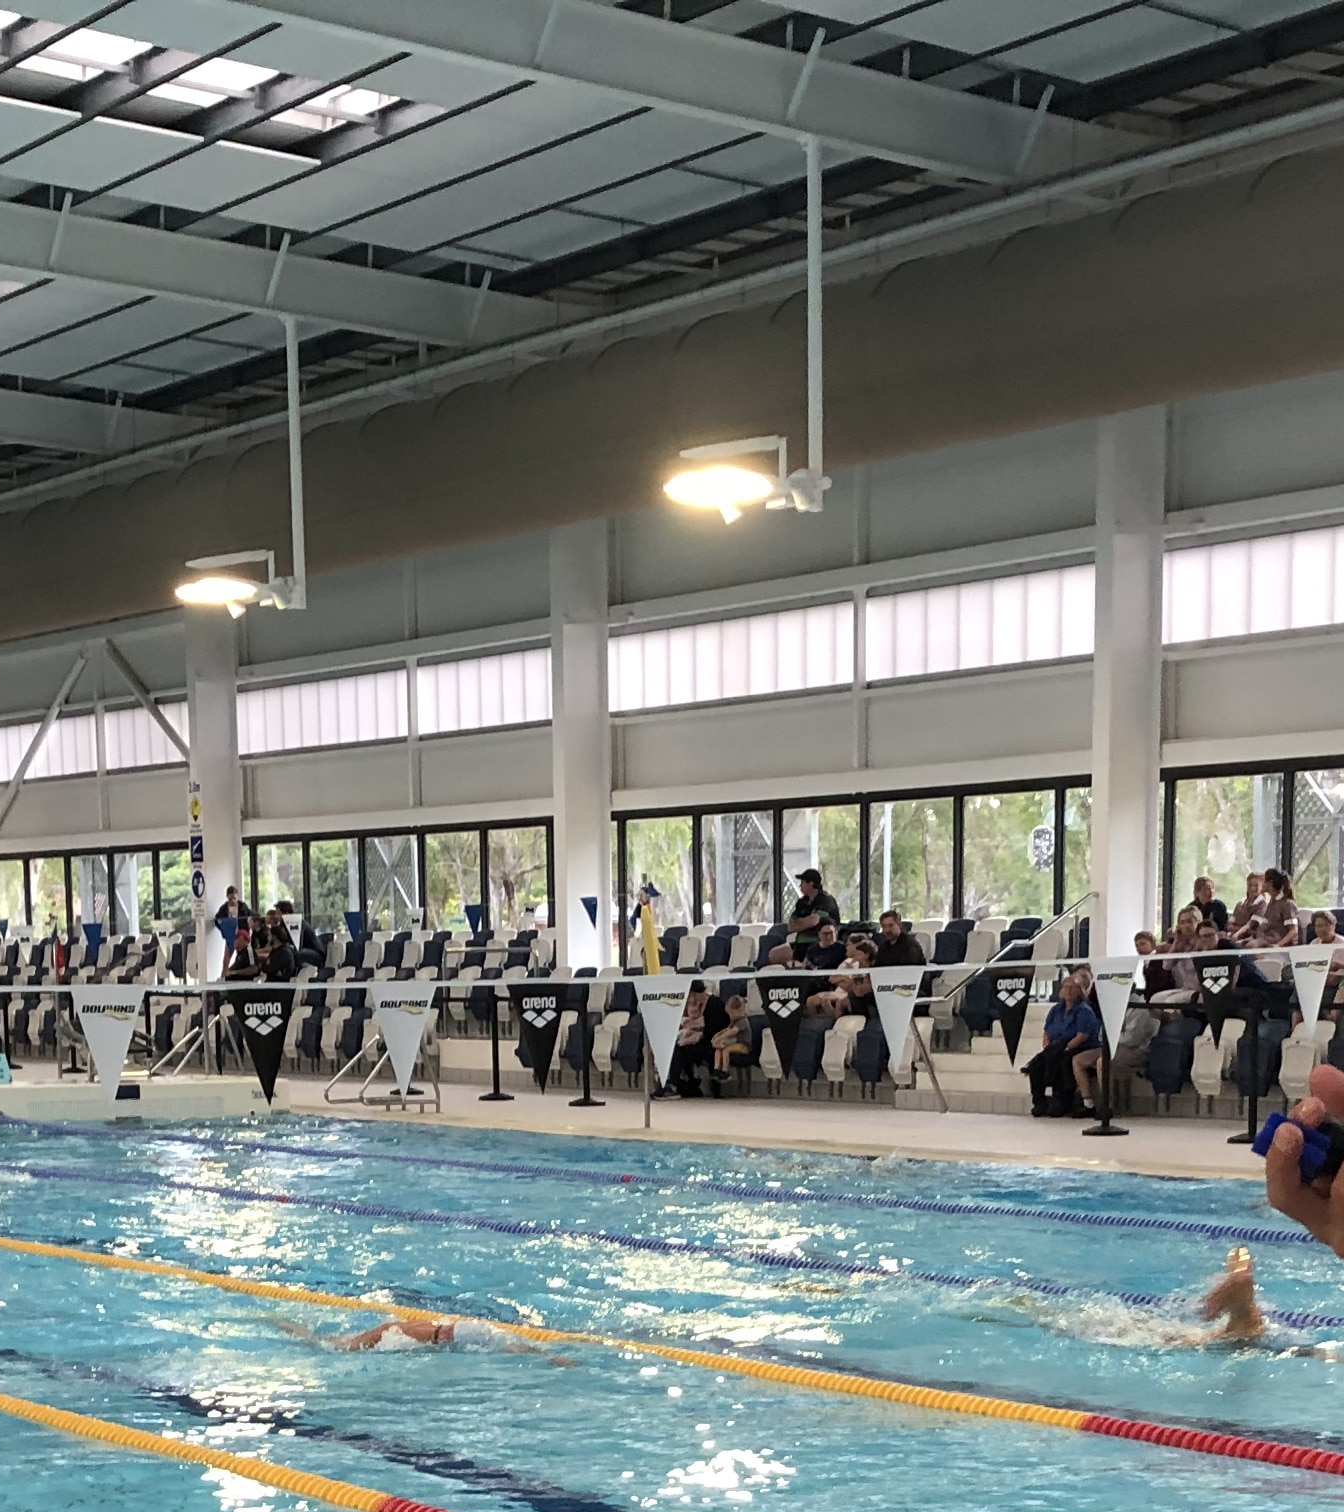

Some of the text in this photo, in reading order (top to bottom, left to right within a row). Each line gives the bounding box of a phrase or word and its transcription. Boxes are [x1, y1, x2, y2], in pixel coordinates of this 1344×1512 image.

[996, 977, 1026, 990] arena
[768, 987, 800, 1001] arena
[81, 1004, 136, 1014] DOLPHINS
[244, 1002, 282, 1016] arena
[522, 996, 556, 1009] arena
